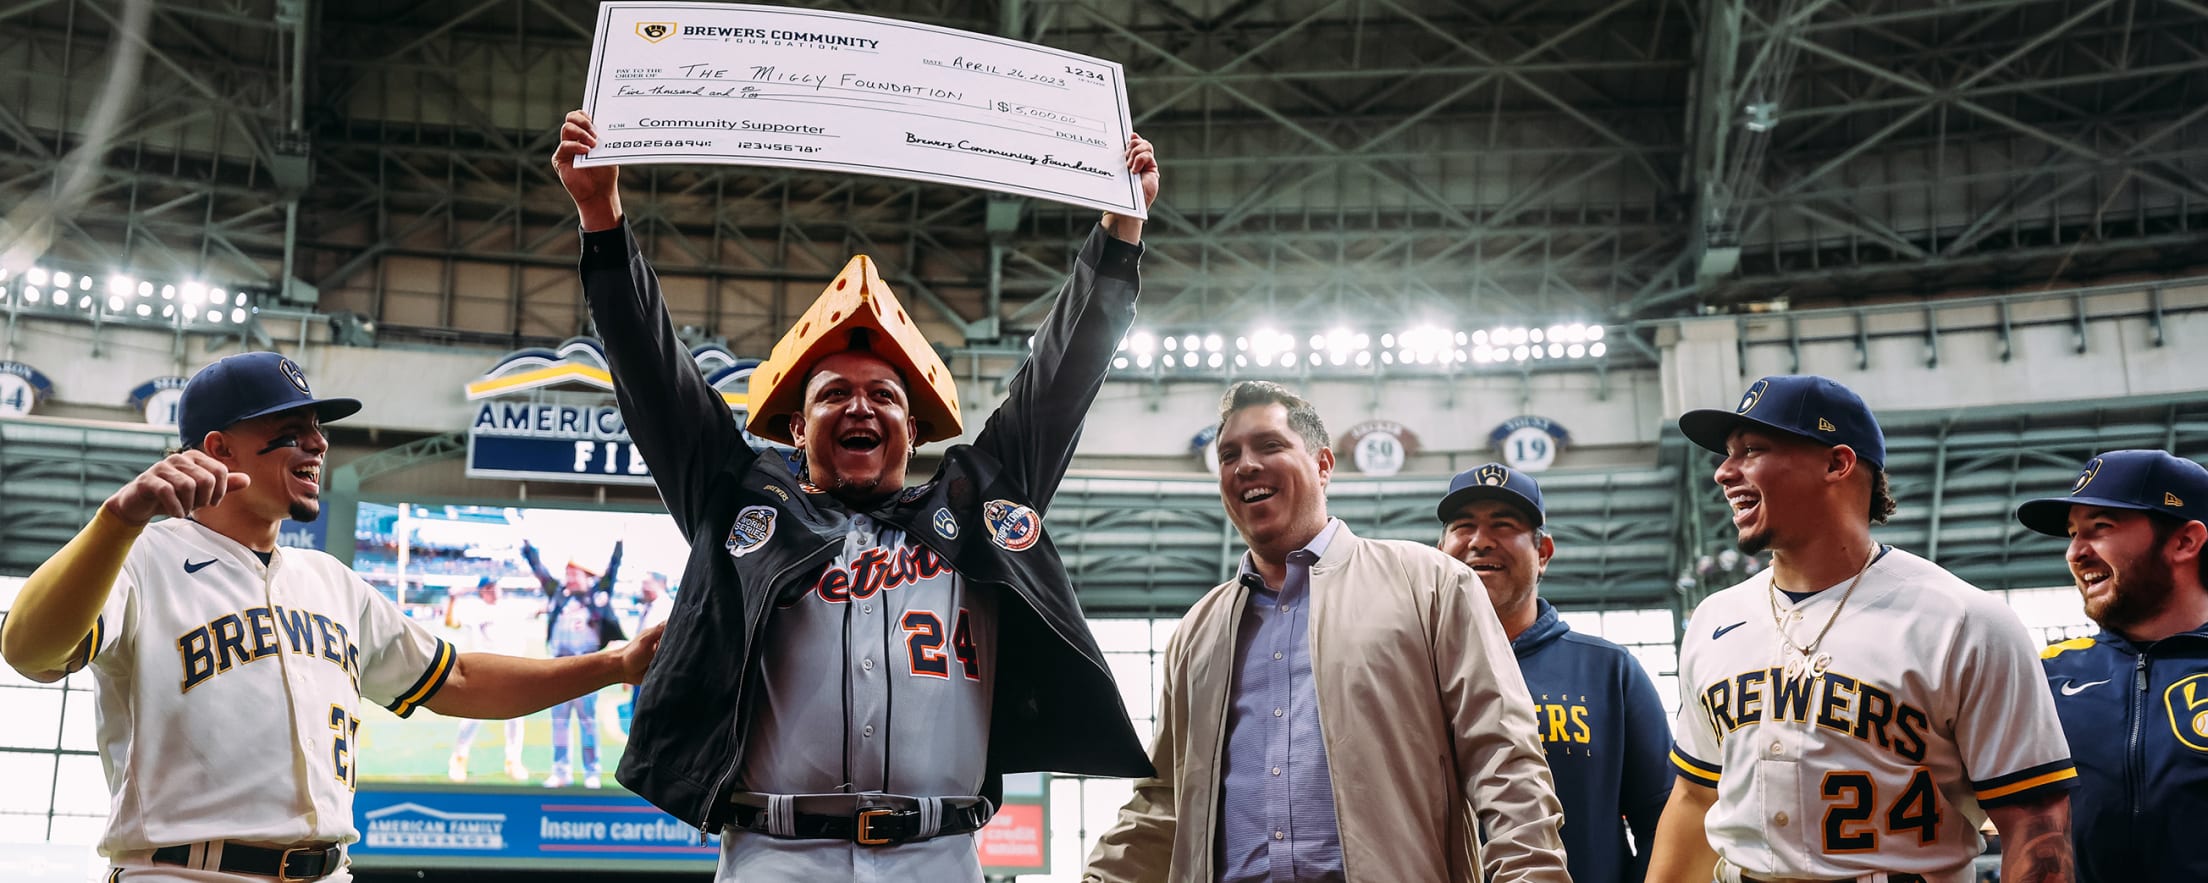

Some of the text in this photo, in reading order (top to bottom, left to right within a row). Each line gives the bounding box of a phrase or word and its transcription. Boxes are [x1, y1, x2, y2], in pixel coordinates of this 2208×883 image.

[683, 25, 879, 49] BREWERS COMMUNITY
[725, 38, 838, 51] FOUNDATION
[923, 58, 943, 66] DATE
[952, 56, 1000, 74] APRIL
[679, 63, 963, 100] THE MIGGY FOUNDATION
[1064, 66, 1105, 82] 1234
[617, 85, 644, 96] Five
[649, 85, 705, 96] thousand
[709, 87, 735, 97] and
[638, 117, 825, 134] Community Supporter
[1055, 131, 1107, 147] DOLLARS
[905, 131, 1115, 178] Brewers Community Foundation
[0, 361, 32, 380] RON
[153, 377, 188, 390] SELI
[475, 404, 627, 435] AMERIC
[573, 441, 651, 476] FIE
[1514, 438, 1547, 461] 19
[763, 484, 789, 502] BREWERS
[734, 521, 767, 541] SERIES
[740, 516, 767, 532] WORLD
[900, 607, 980, 681] 24
[1541, 693, 1587, 703] KEE
[1701, 665, 1930, 763] REWERS
[1542, 747, 1592, 757] ALL
[1820, 765, 1943, 855] 24
[367, 819, 503, 834] AMERICAN FAMILY
[540, 815, 607, 840] Insure
